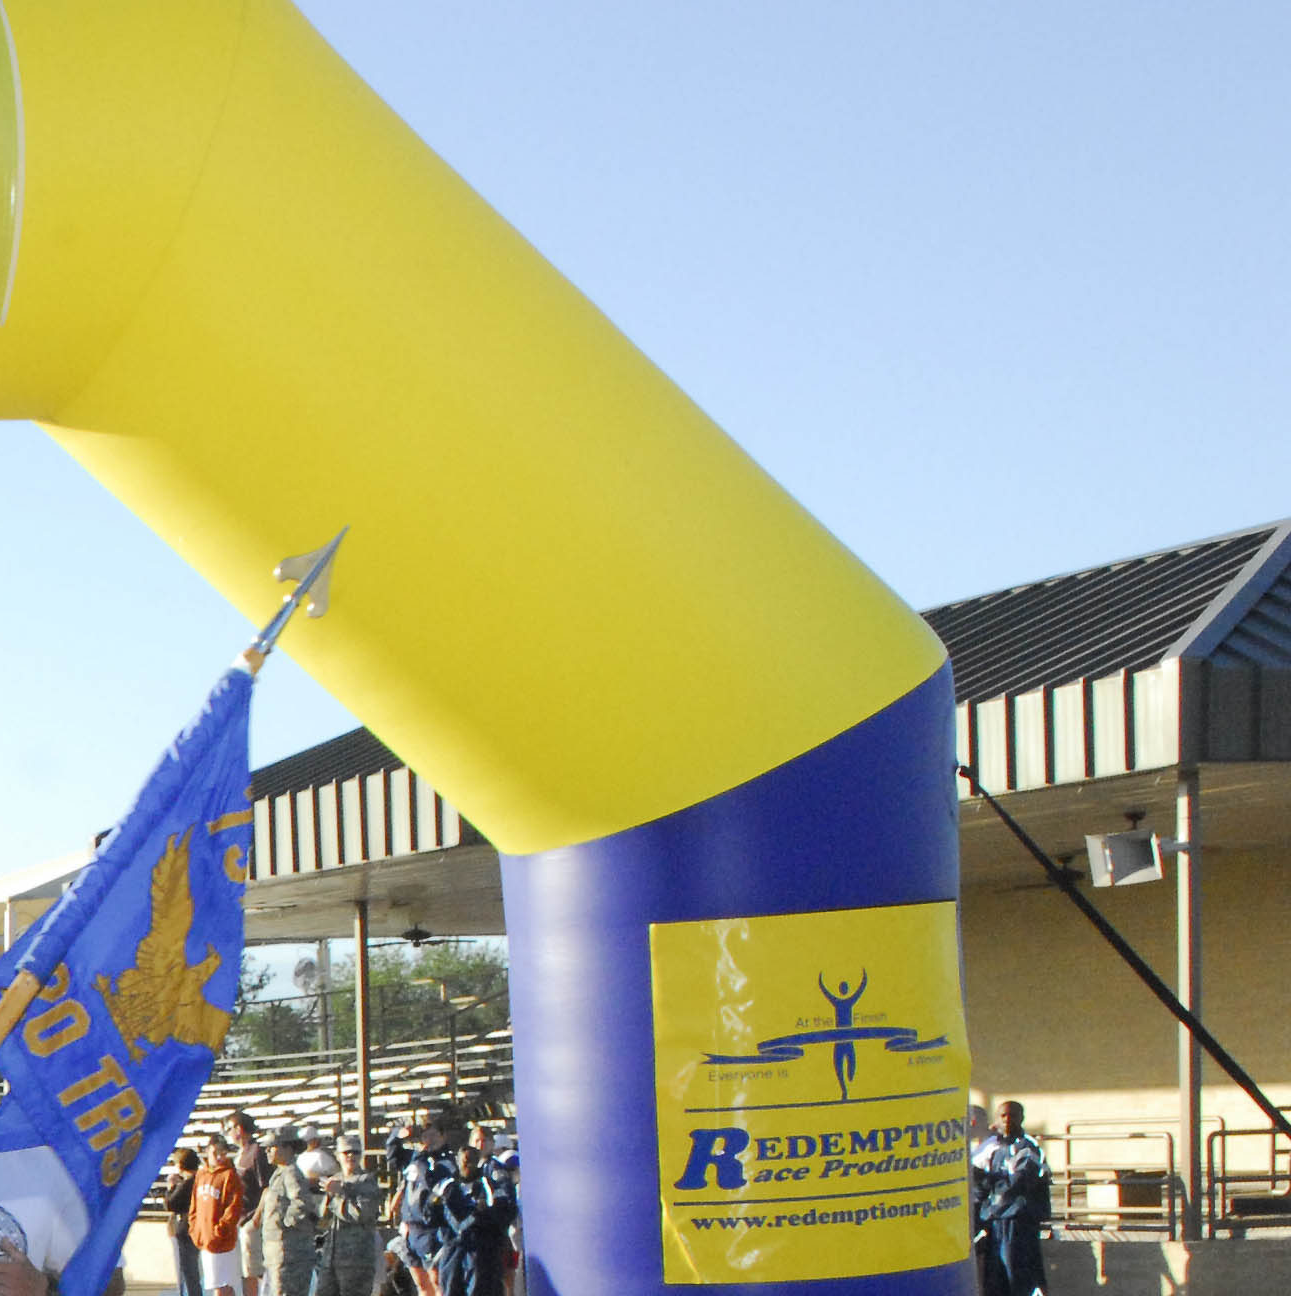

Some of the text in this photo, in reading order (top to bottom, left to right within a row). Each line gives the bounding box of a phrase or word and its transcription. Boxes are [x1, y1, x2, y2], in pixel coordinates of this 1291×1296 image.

[673, 1116, 968, 1191] REDEMPTION
[818, 1147, 967, 1181] Productions
[690, 1195, 962, 1231] www.redemptionrp.com
